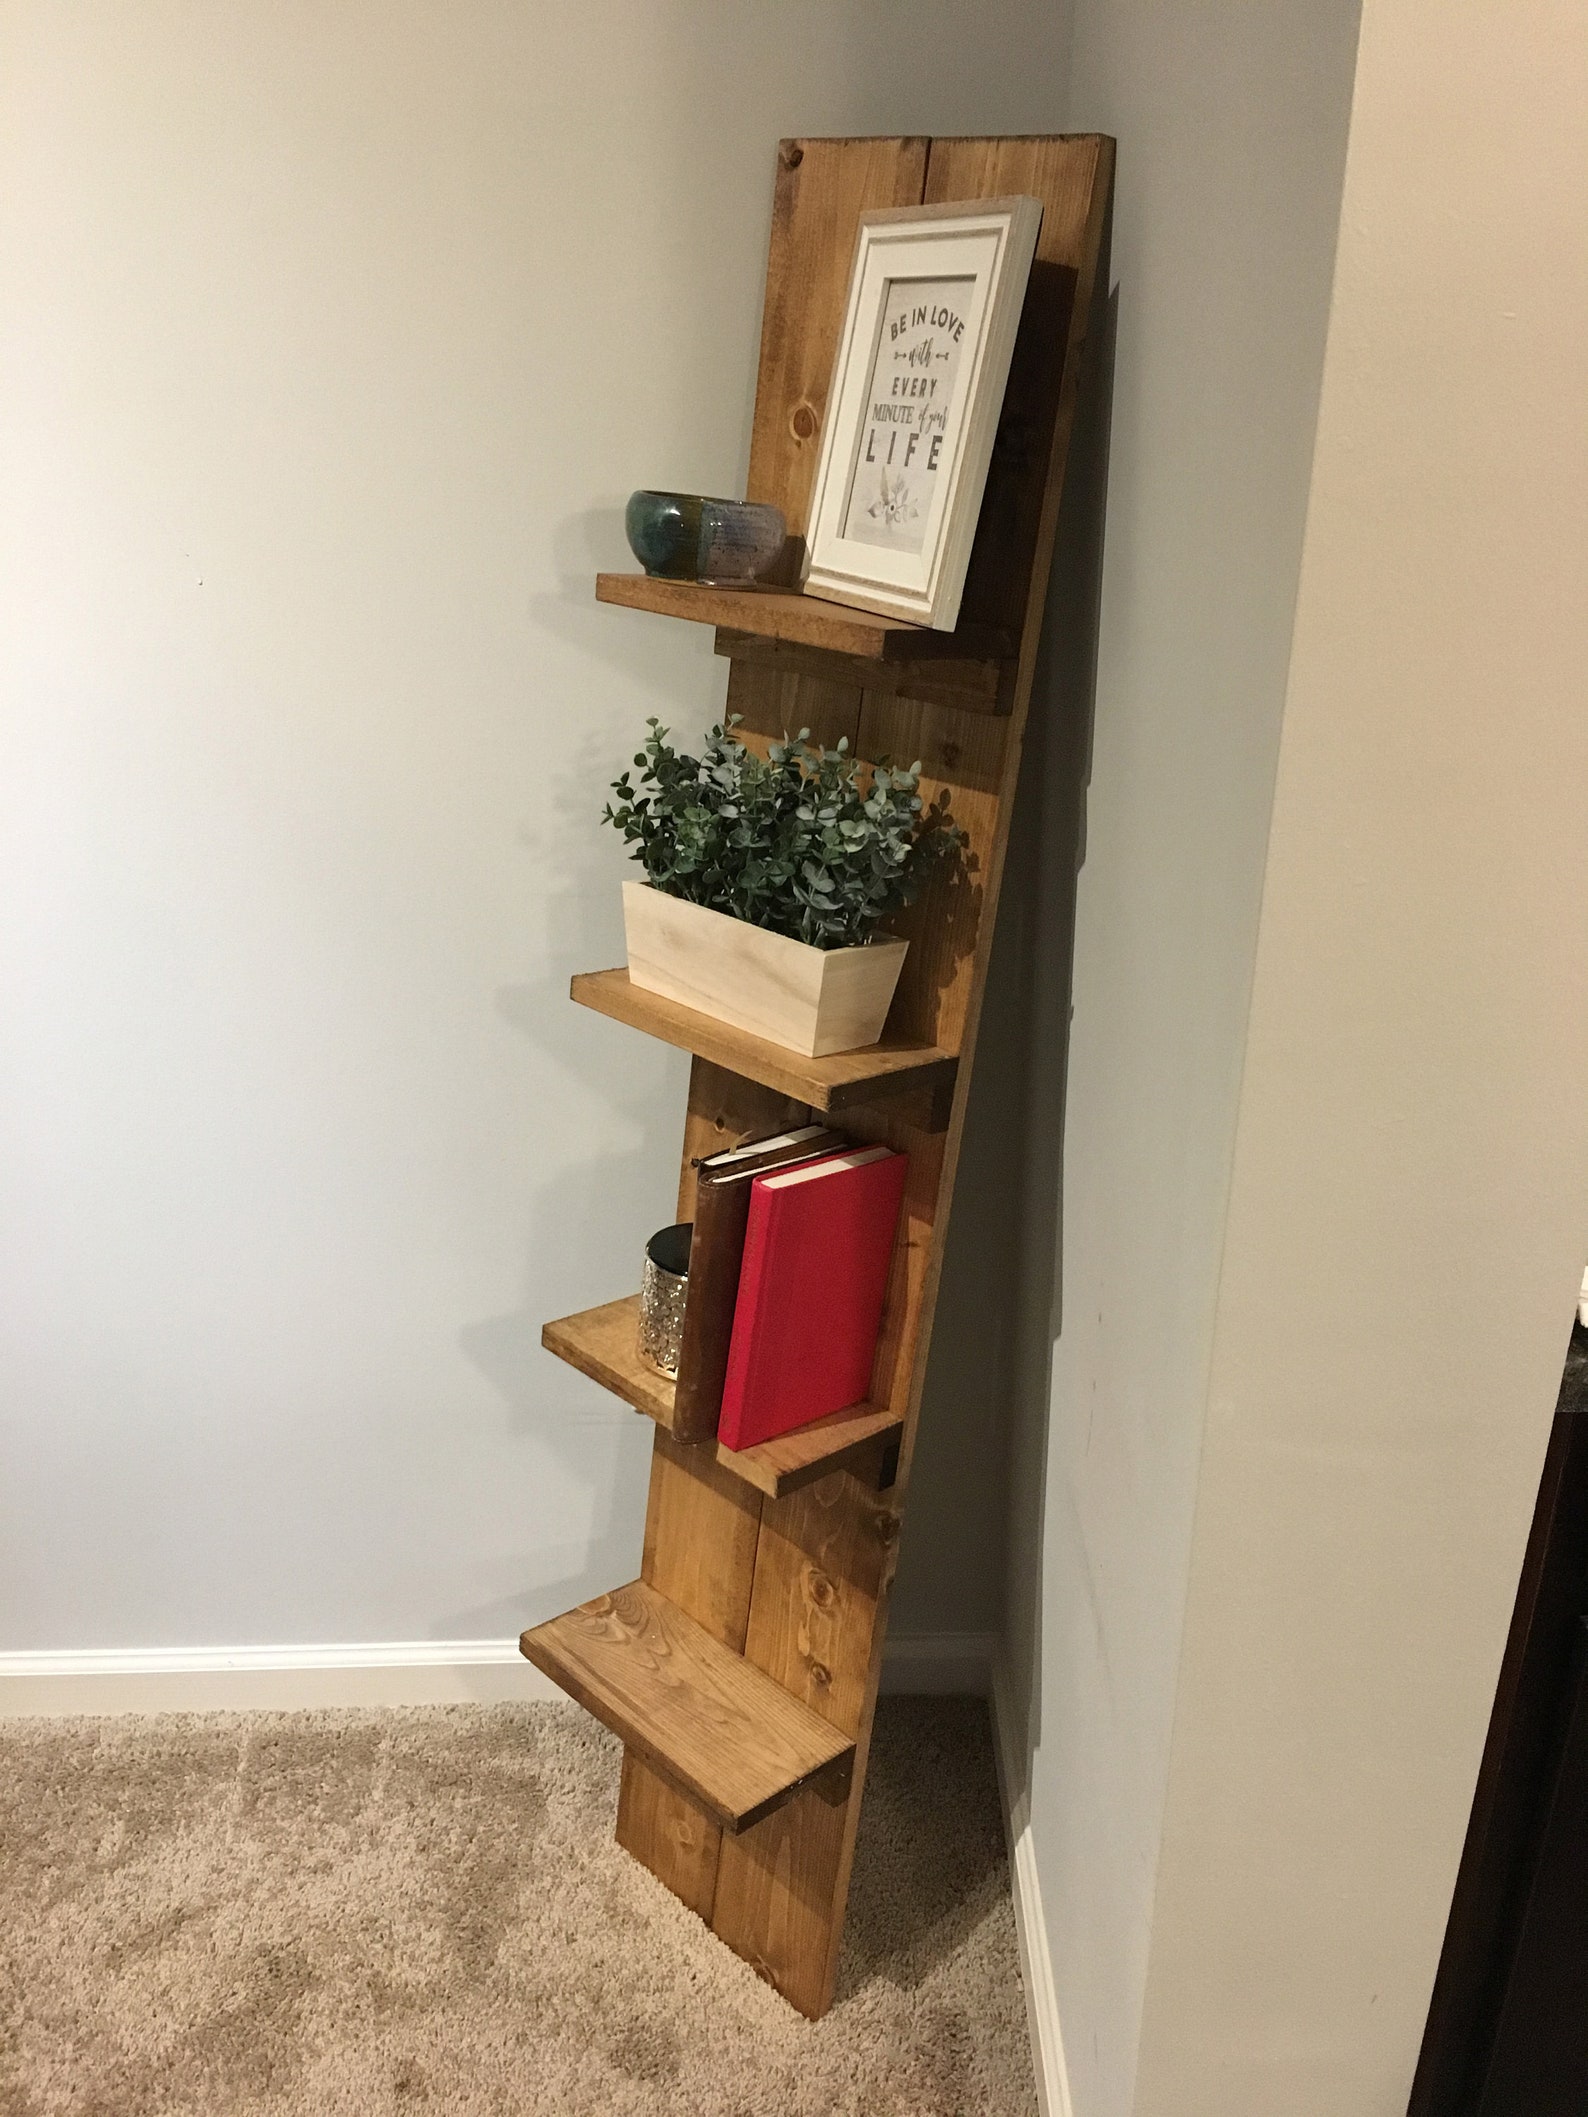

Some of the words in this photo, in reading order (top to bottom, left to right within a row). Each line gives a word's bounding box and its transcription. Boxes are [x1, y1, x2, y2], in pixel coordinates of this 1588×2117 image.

[890, 314, 907, 341] BE
[911, 305, 928, 327] IN
[930, 305, 965, 343] LOVE
[908, 337, 934, 368] with
[892, 377, 937, 398] EVERY
[872, 403, 915, 424] MINUTE
[918, 403, 929, 434] of
[865, 428, 943, 471] LIFE
